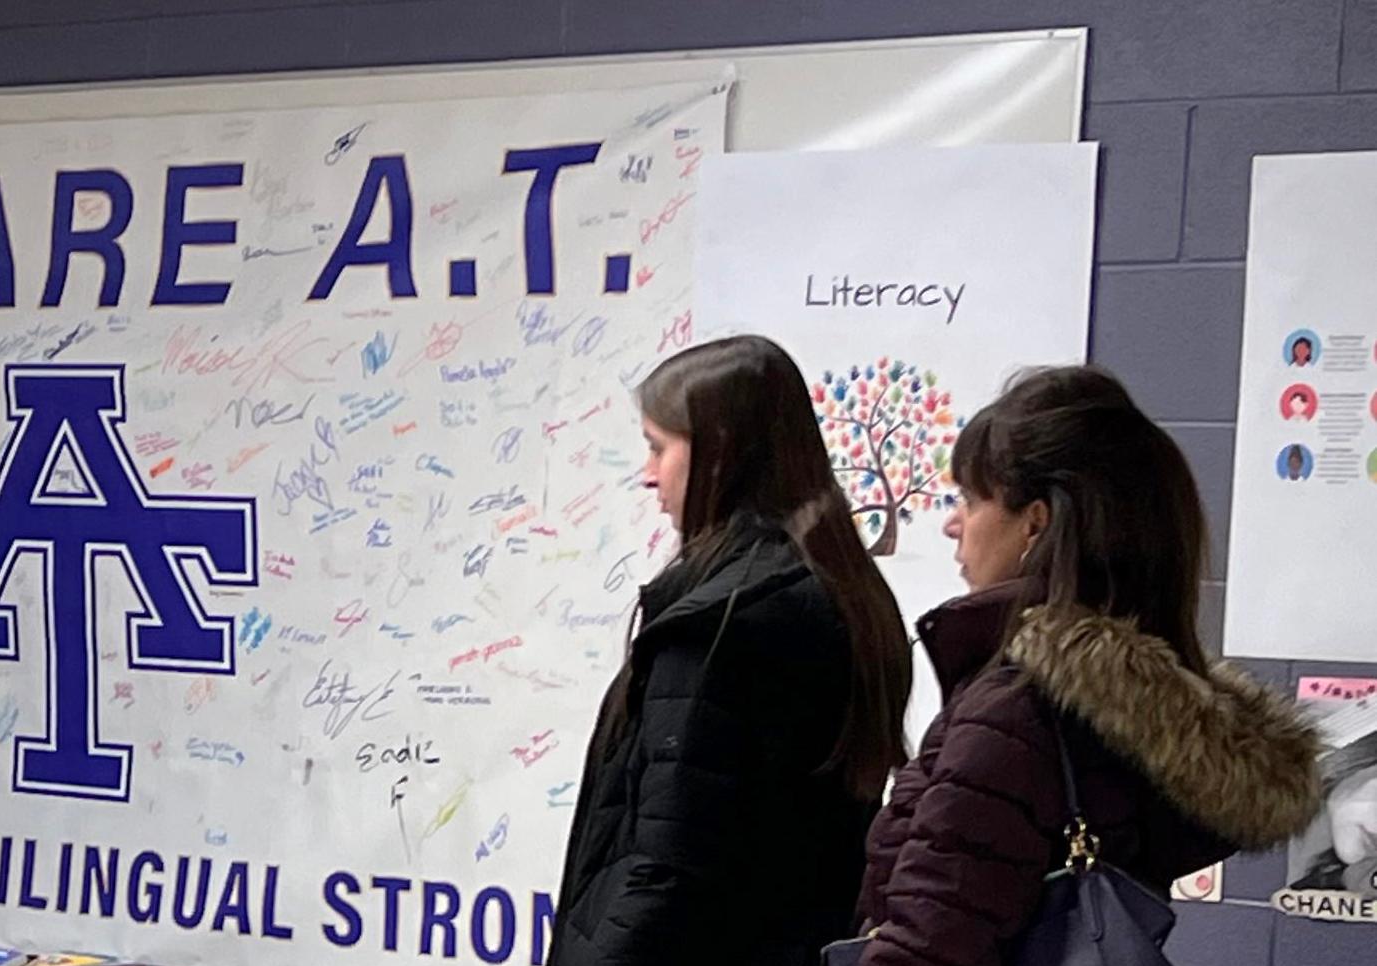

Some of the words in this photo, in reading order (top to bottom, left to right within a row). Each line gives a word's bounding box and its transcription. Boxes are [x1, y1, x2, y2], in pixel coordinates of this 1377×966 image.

[303, 140, 632, 301] A.T.
[804, 274, 966, 325] Literacy
[321, 870, 556, 966] STRON
[1279, 893, 1375, 919] CHANE
